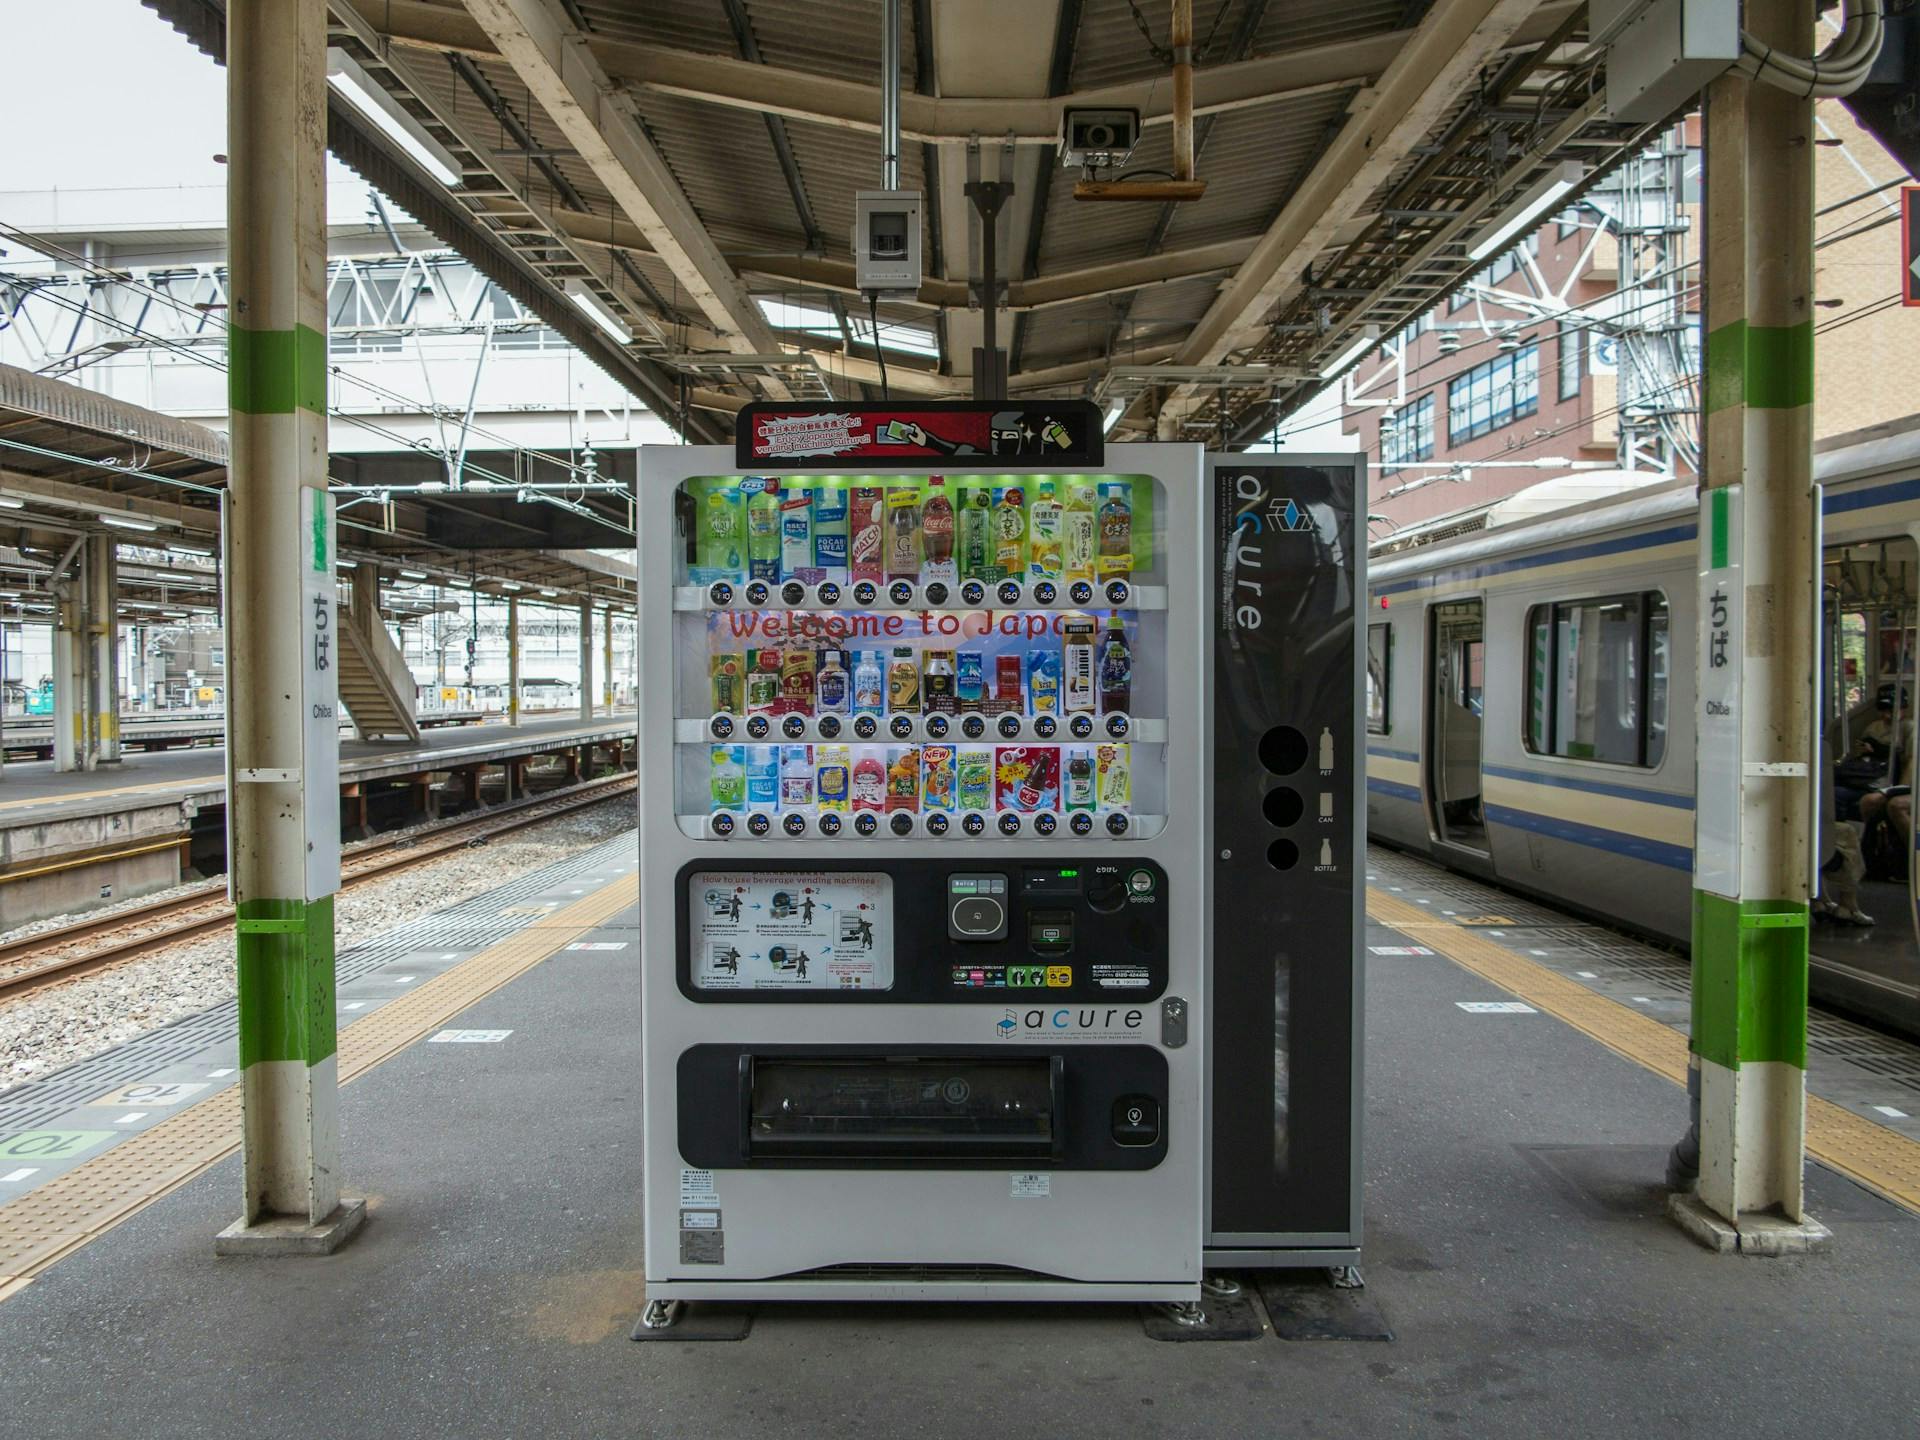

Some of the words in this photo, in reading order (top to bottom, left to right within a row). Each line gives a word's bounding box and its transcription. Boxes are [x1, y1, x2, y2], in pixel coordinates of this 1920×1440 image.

[757, 443, 793, 454] vending
[795, 439, 831, 449] machine
[776, 435, 802, 445] Enjoy
[803, 431, 844, 442] Japanese
[854, 526, 879, 556] MATCH
[1235, 474, 1263, 630] acure
[313, 592, 330, 671] ちば
[729, 609, 904, 638] Welcome
[918, 609, 960, 635] to
[1710, 590, 1728, 668] ちば
[313, 704, 332, 719] Chiba
[1706, 701, 1730, 716] Chiba
[924, 750, 947, 760] NEW
[753, 876, 794, 885] beverage
[798, 877, 832, 885] vending
[834, 877, 876, 885] machines
[1024, 1009, 1143, 1029] acure
[8, 1135, 83, 1155] 10
